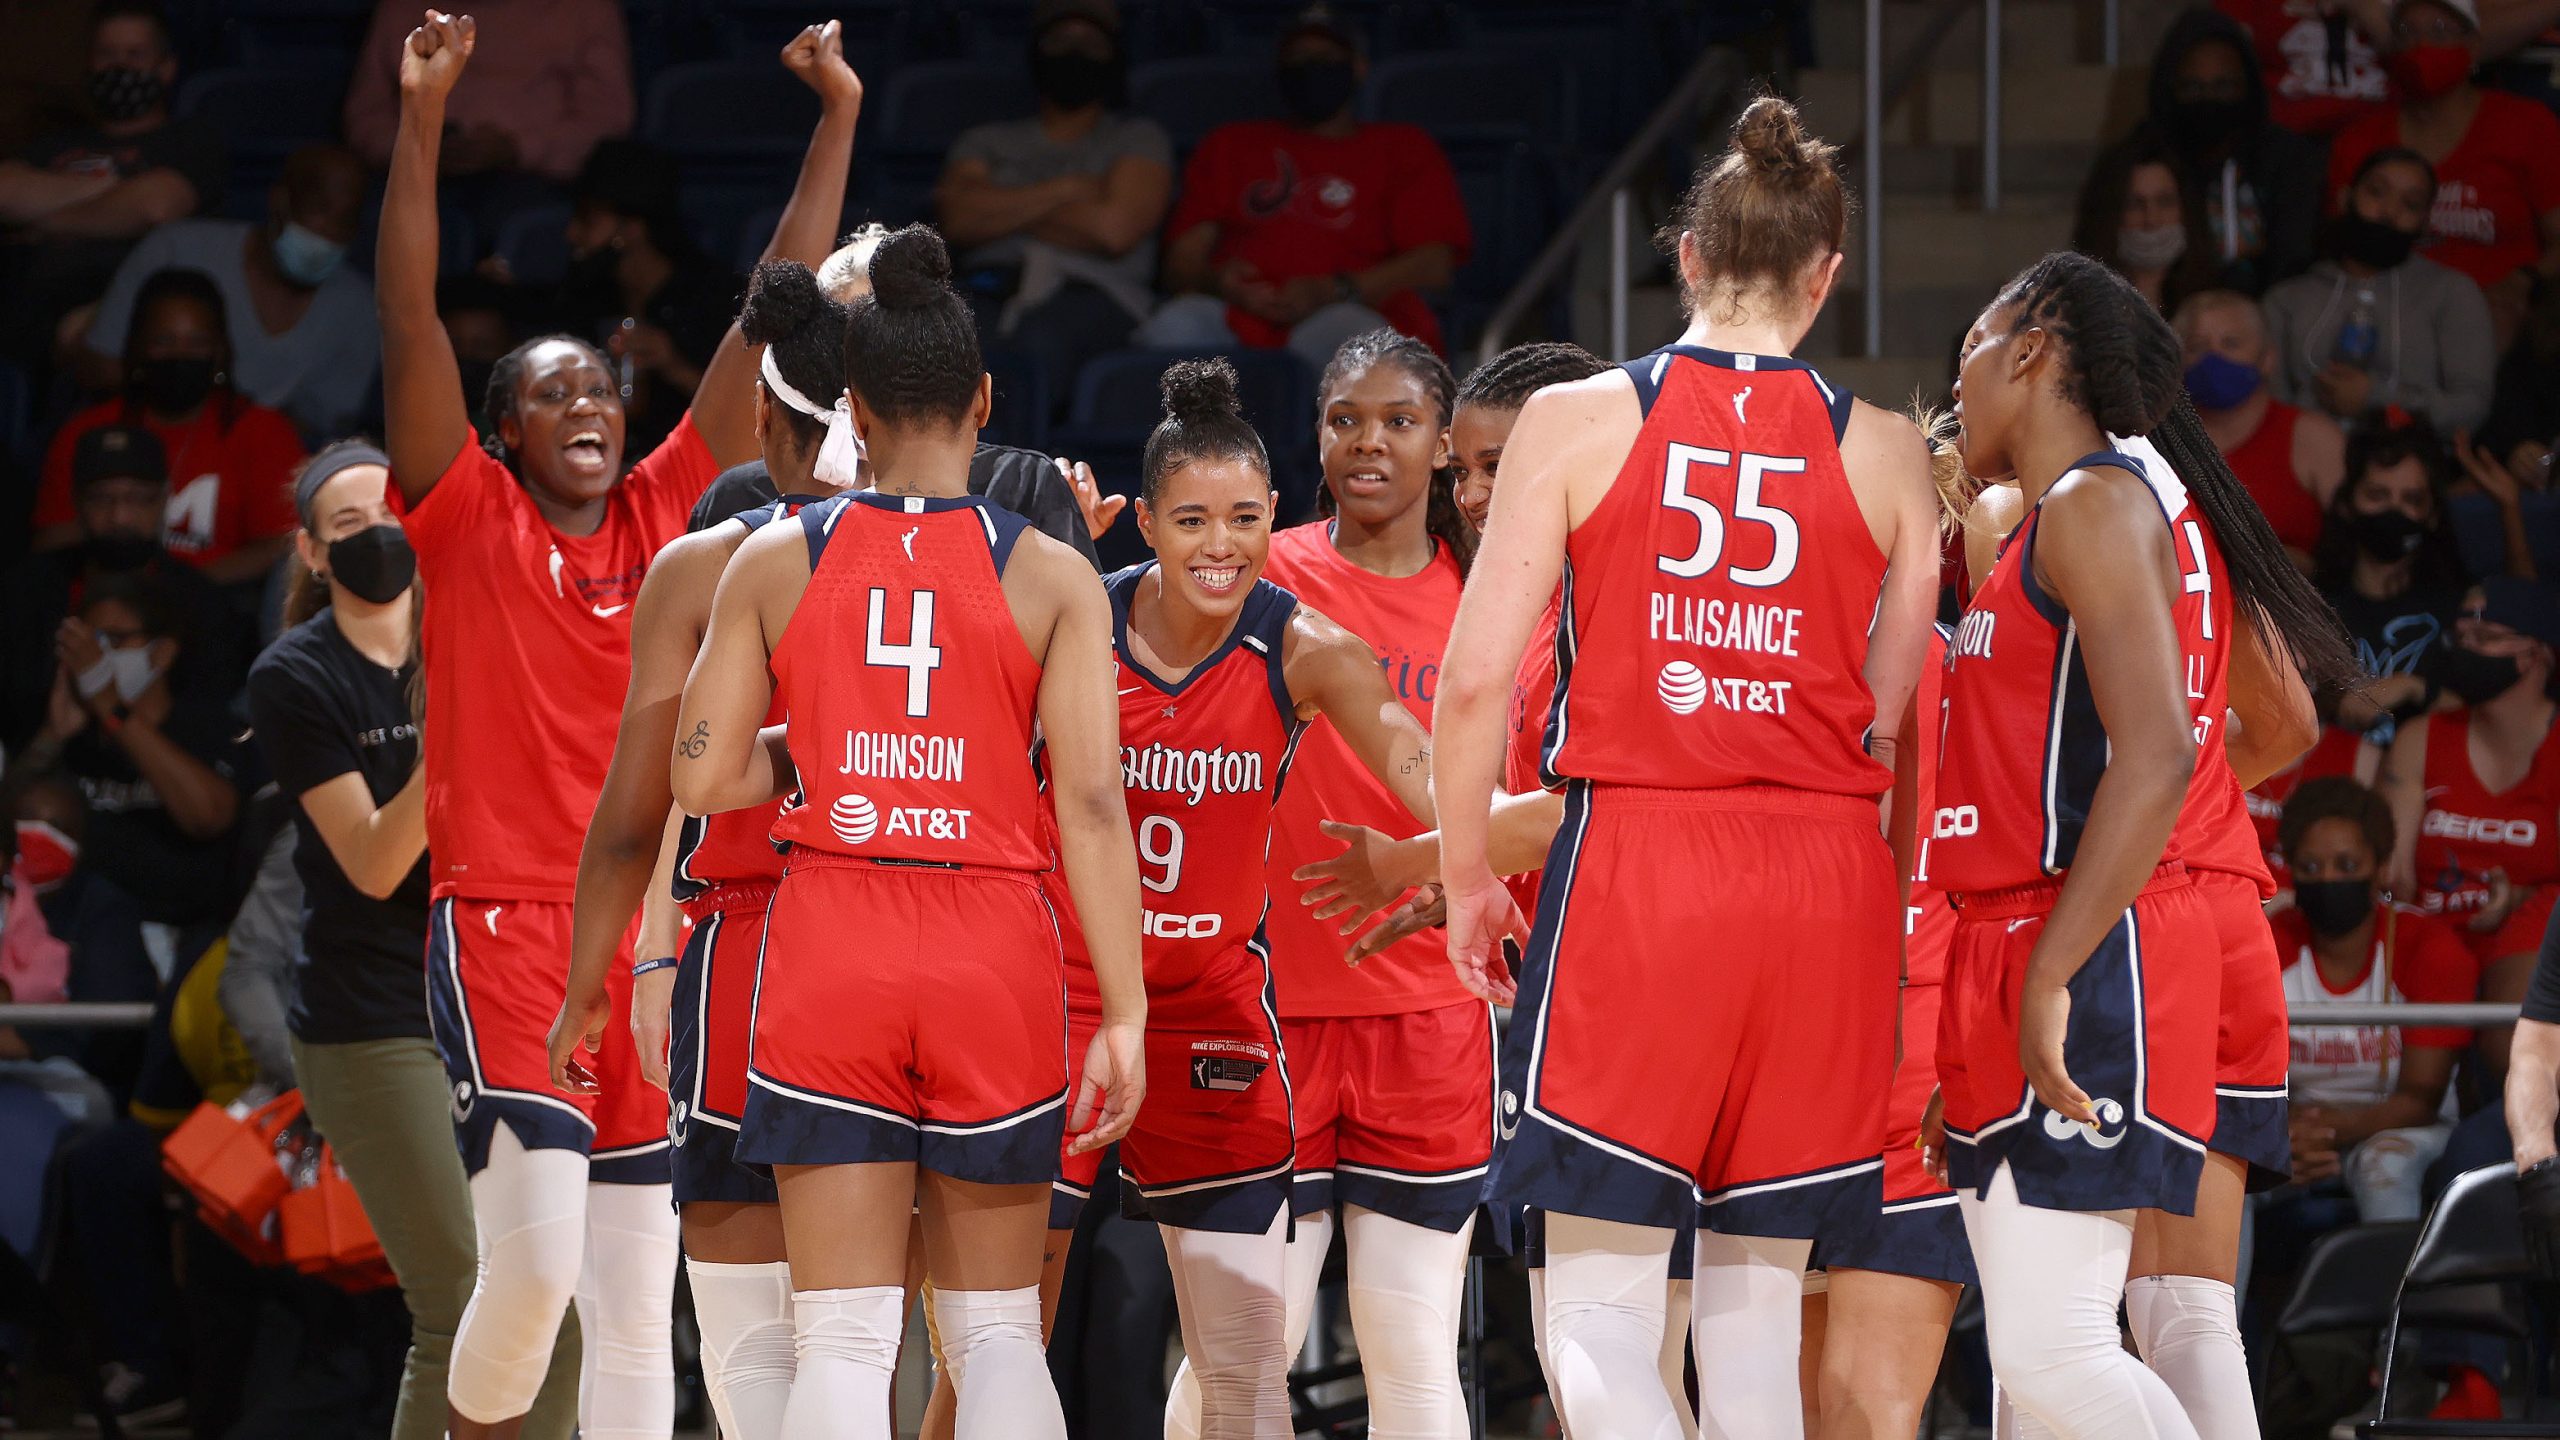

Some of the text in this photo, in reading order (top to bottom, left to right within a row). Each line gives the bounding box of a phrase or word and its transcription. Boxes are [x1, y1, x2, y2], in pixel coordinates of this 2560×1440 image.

[1656, 440, 1807, 588] 55
[1650, 591, 1803, 657] PLAISANCE
[863, 586, 942, 718] 4
[1711, 676, 1793, 716] AT&T
[838, 729, 966, 783] JOHNSON
[884, 805, 972, 841] AT&T
[2423, 808, 2538, 848] GEICO
[1138, 812, 1186, 894] 9
[1209, 1042, 1246, 1053] EXPLORER
